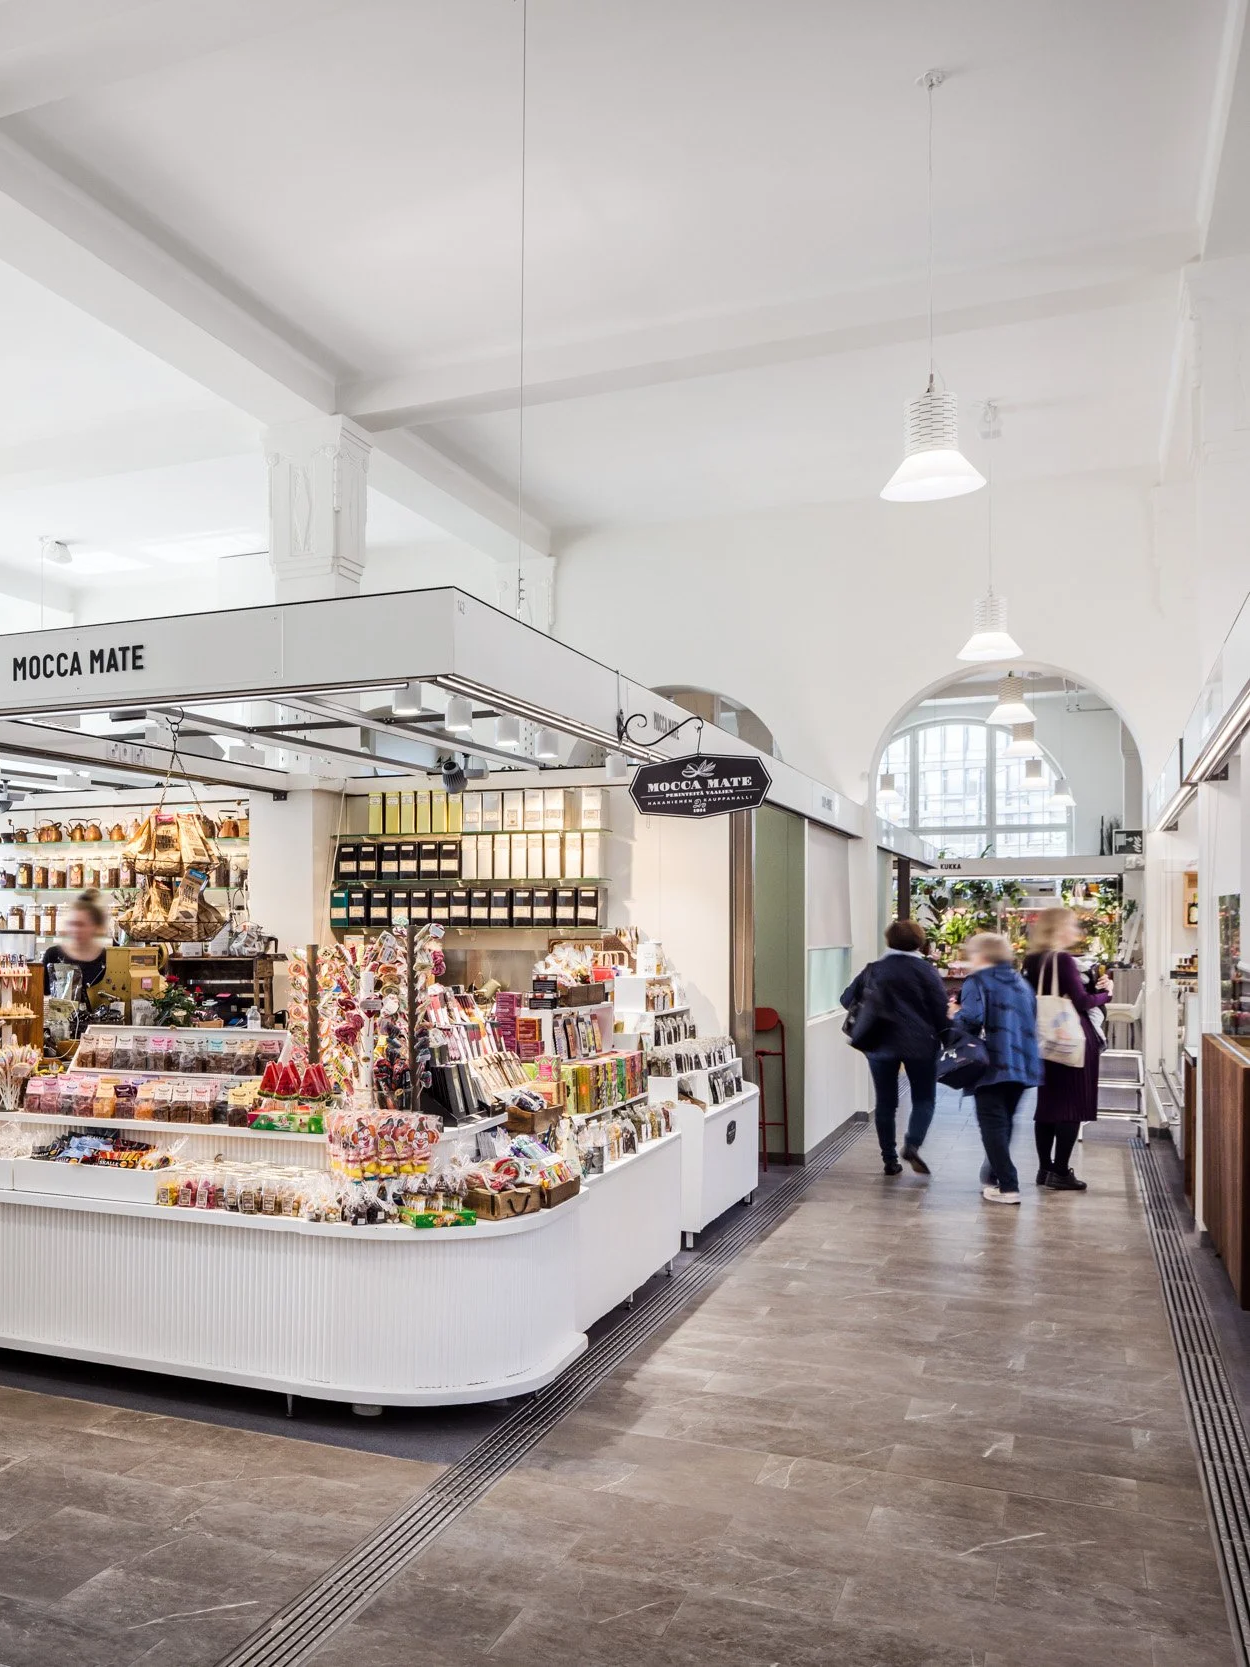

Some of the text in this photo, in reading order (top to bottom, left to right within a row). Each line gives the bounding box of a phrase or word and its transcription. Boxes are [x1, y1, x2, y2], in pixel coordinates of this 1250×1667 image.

[13, 644, 144, 681] MOCCA MATE
[653, 711, 668, 734] MOCCA
[647, 776, 752, 792] MOCCA MATE
